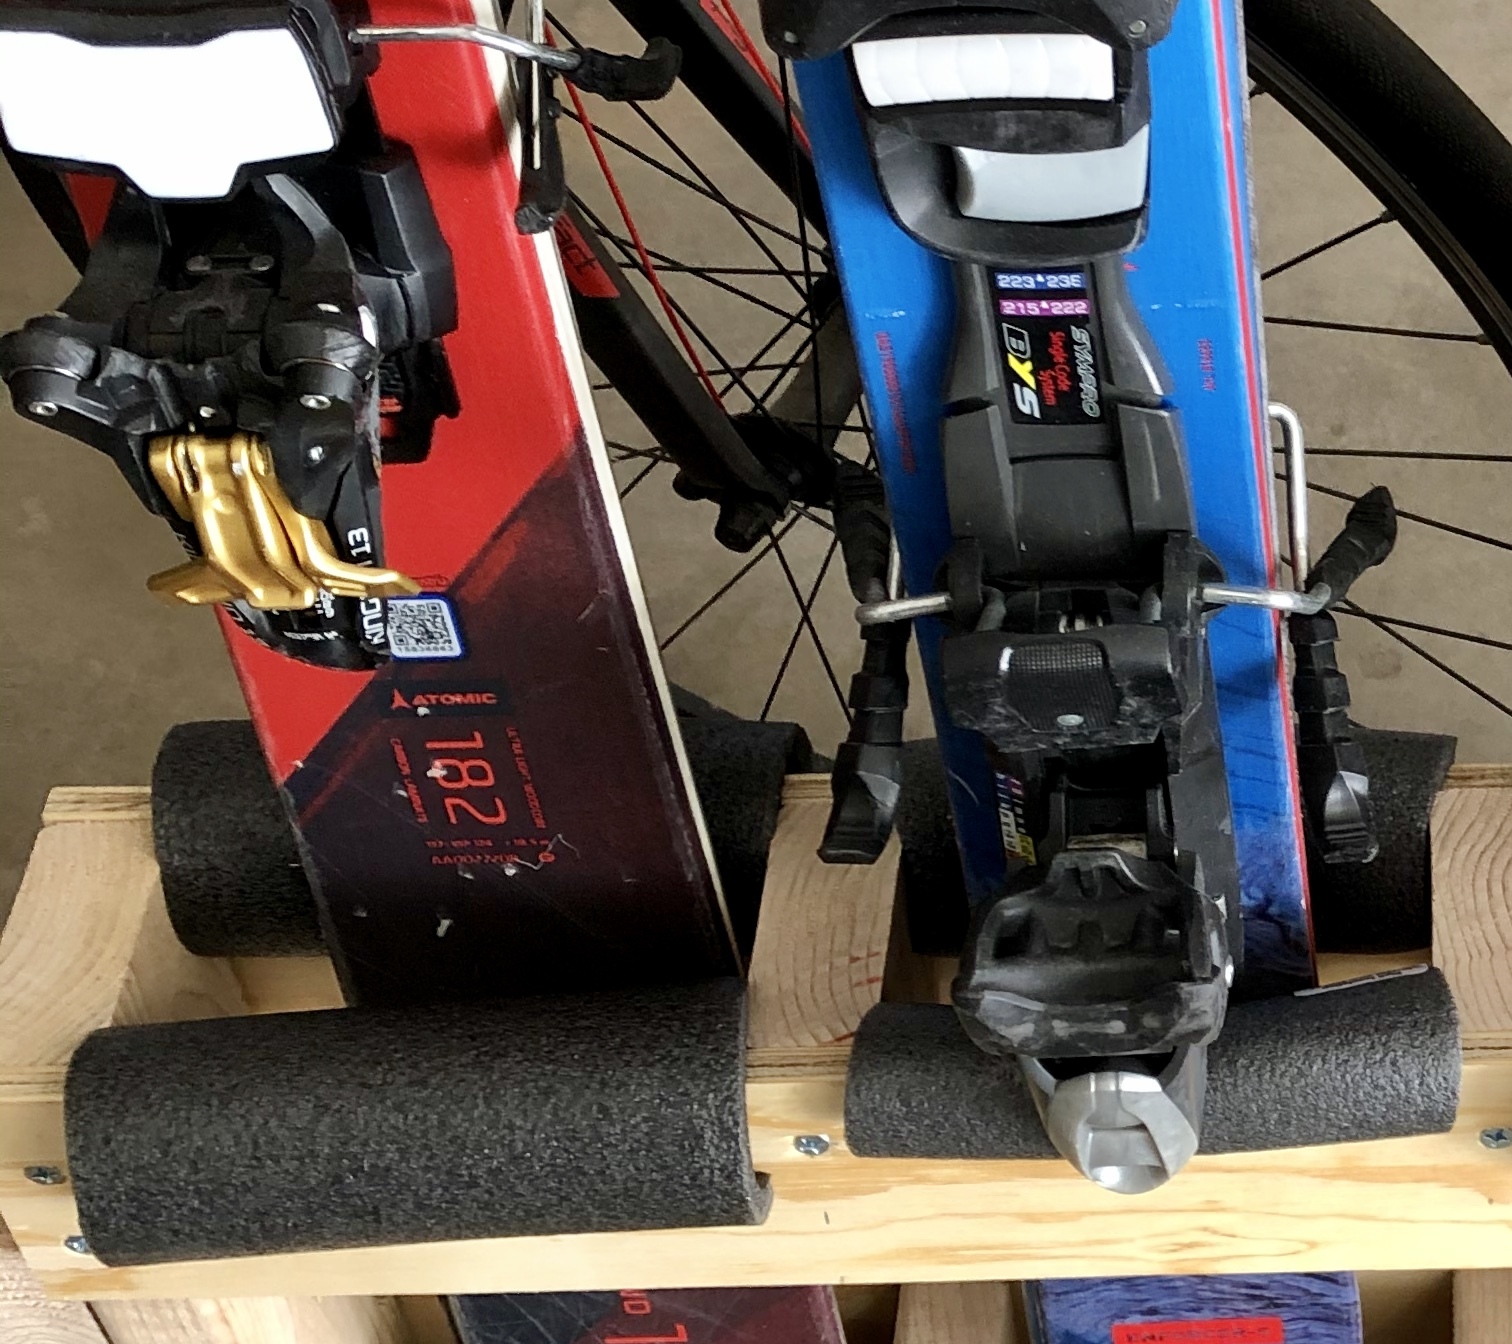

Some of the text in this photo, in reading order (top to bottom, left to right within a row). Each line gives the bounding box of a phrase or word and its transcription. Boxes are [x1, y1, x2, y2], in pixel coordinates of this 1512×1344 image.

[1070, 325, 1101, 418] SYMPRO
[347, 527, 372, 557] 13
[412, 692, 498, 706] ATOMIC
[425, 730, 508, 825] 182
